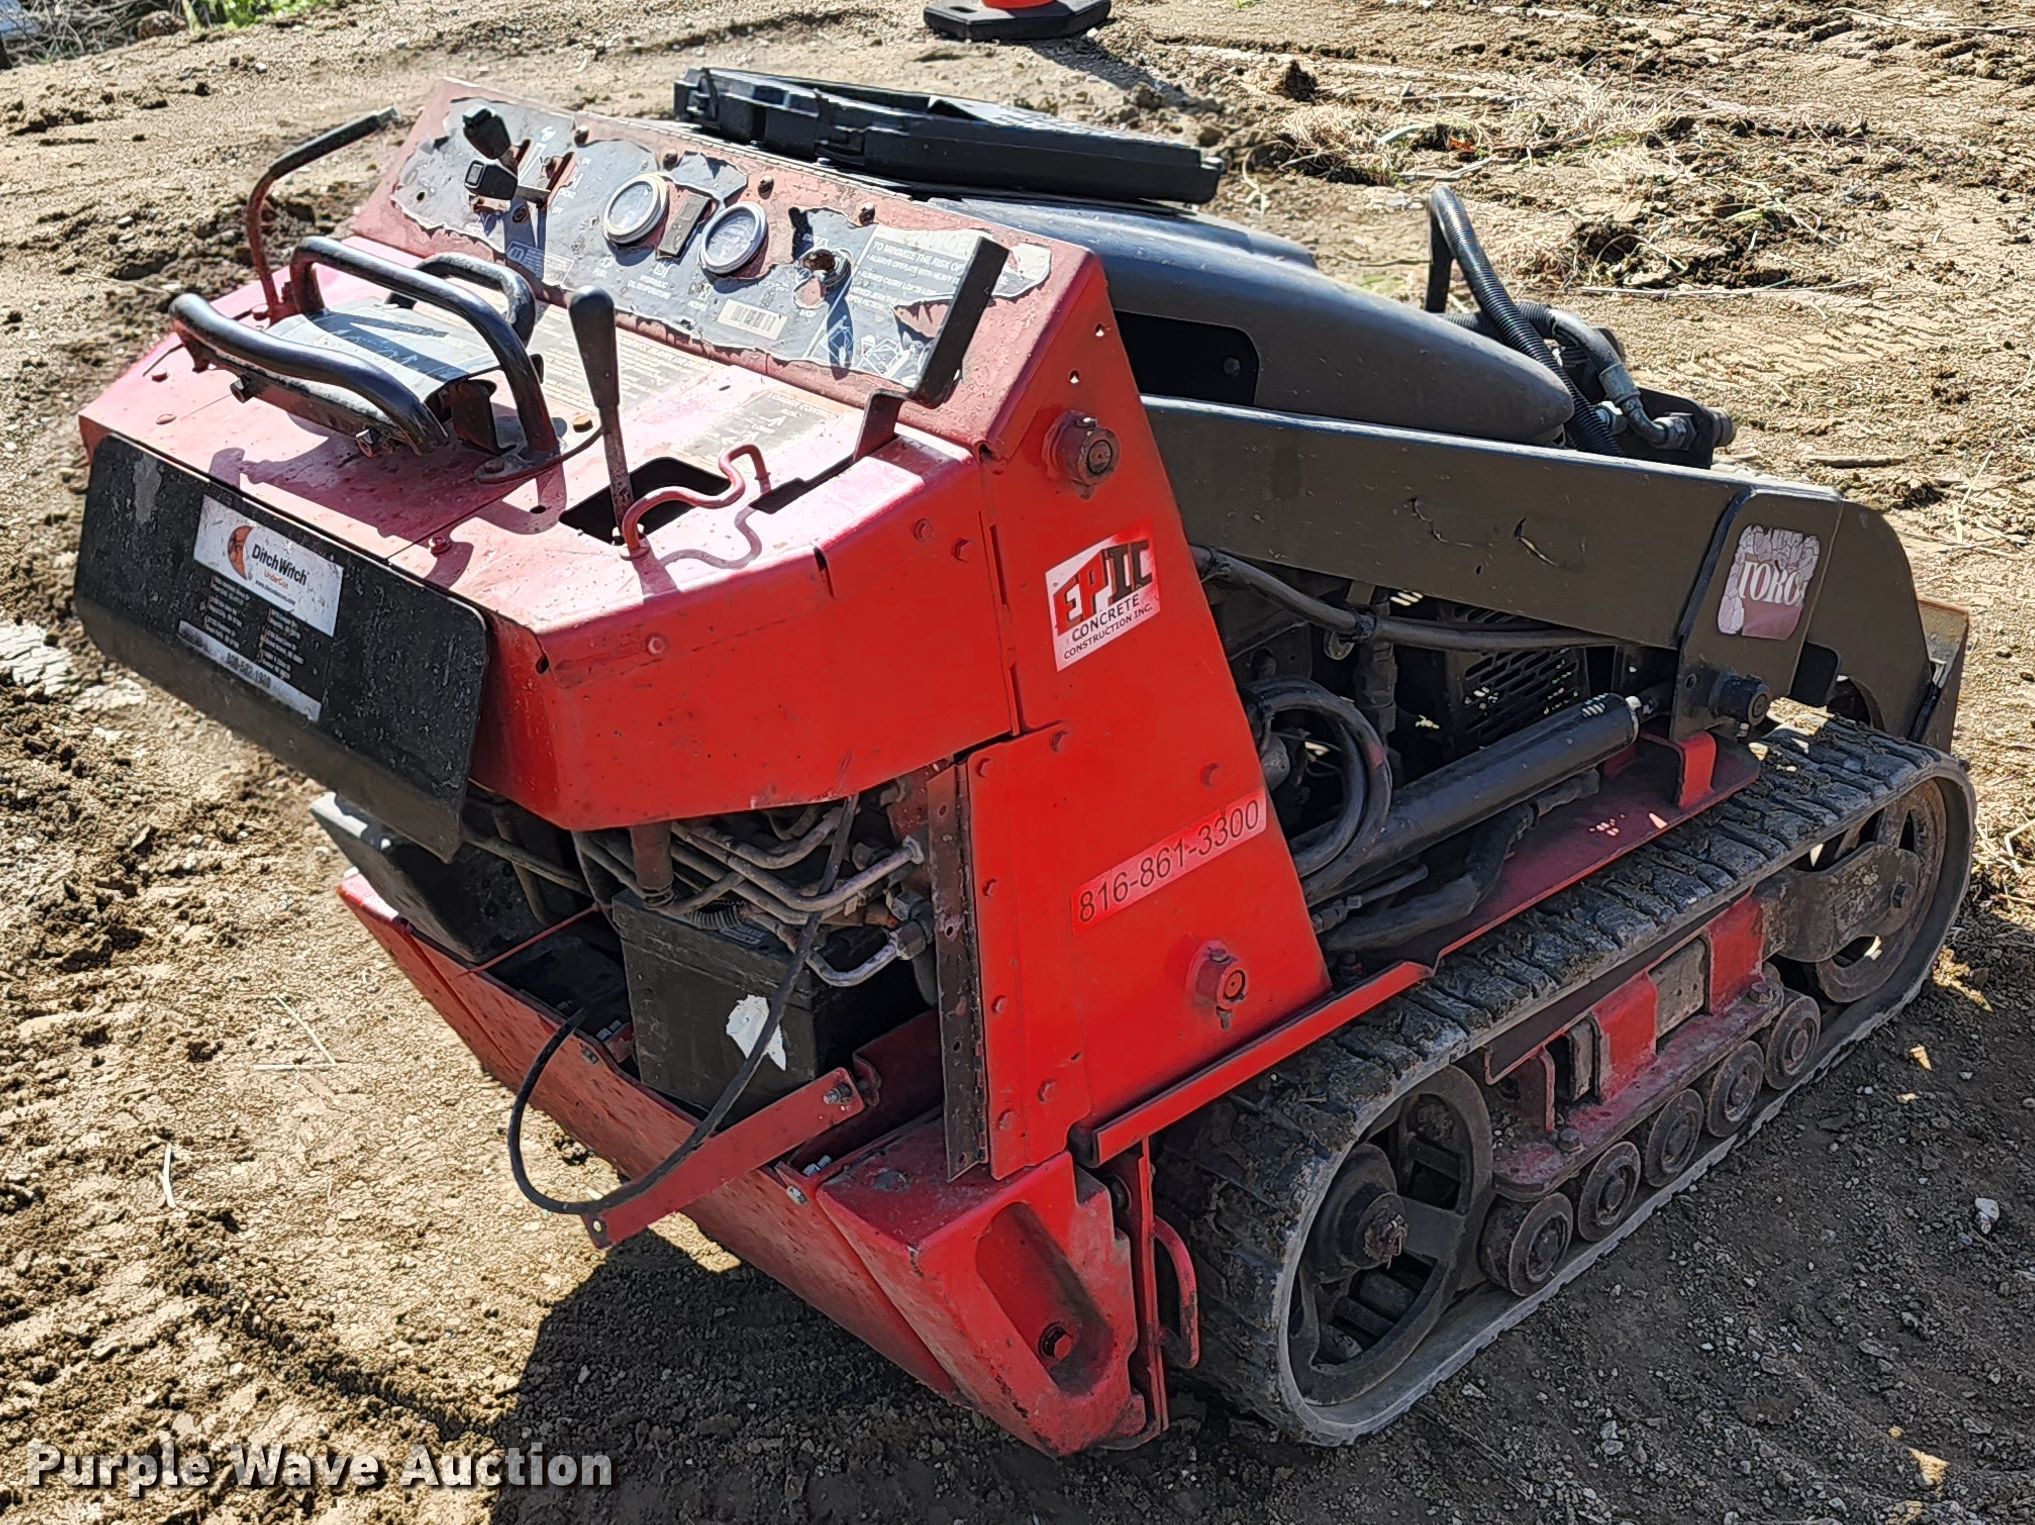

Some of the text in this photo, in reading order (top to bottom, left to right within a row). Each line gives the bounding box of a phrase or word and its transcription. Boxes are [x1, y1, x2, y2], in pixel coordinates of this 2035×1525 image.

[872, 241, 884, 251] TO
[1053, 538, 1153, 637] EPIC
[1063, 603, 1153, 660] CONSTRUCTION INC.
[1071, 594, 1141, 642] CONCRETE
[1078, 799, 1260, 924] 816-861-3300
